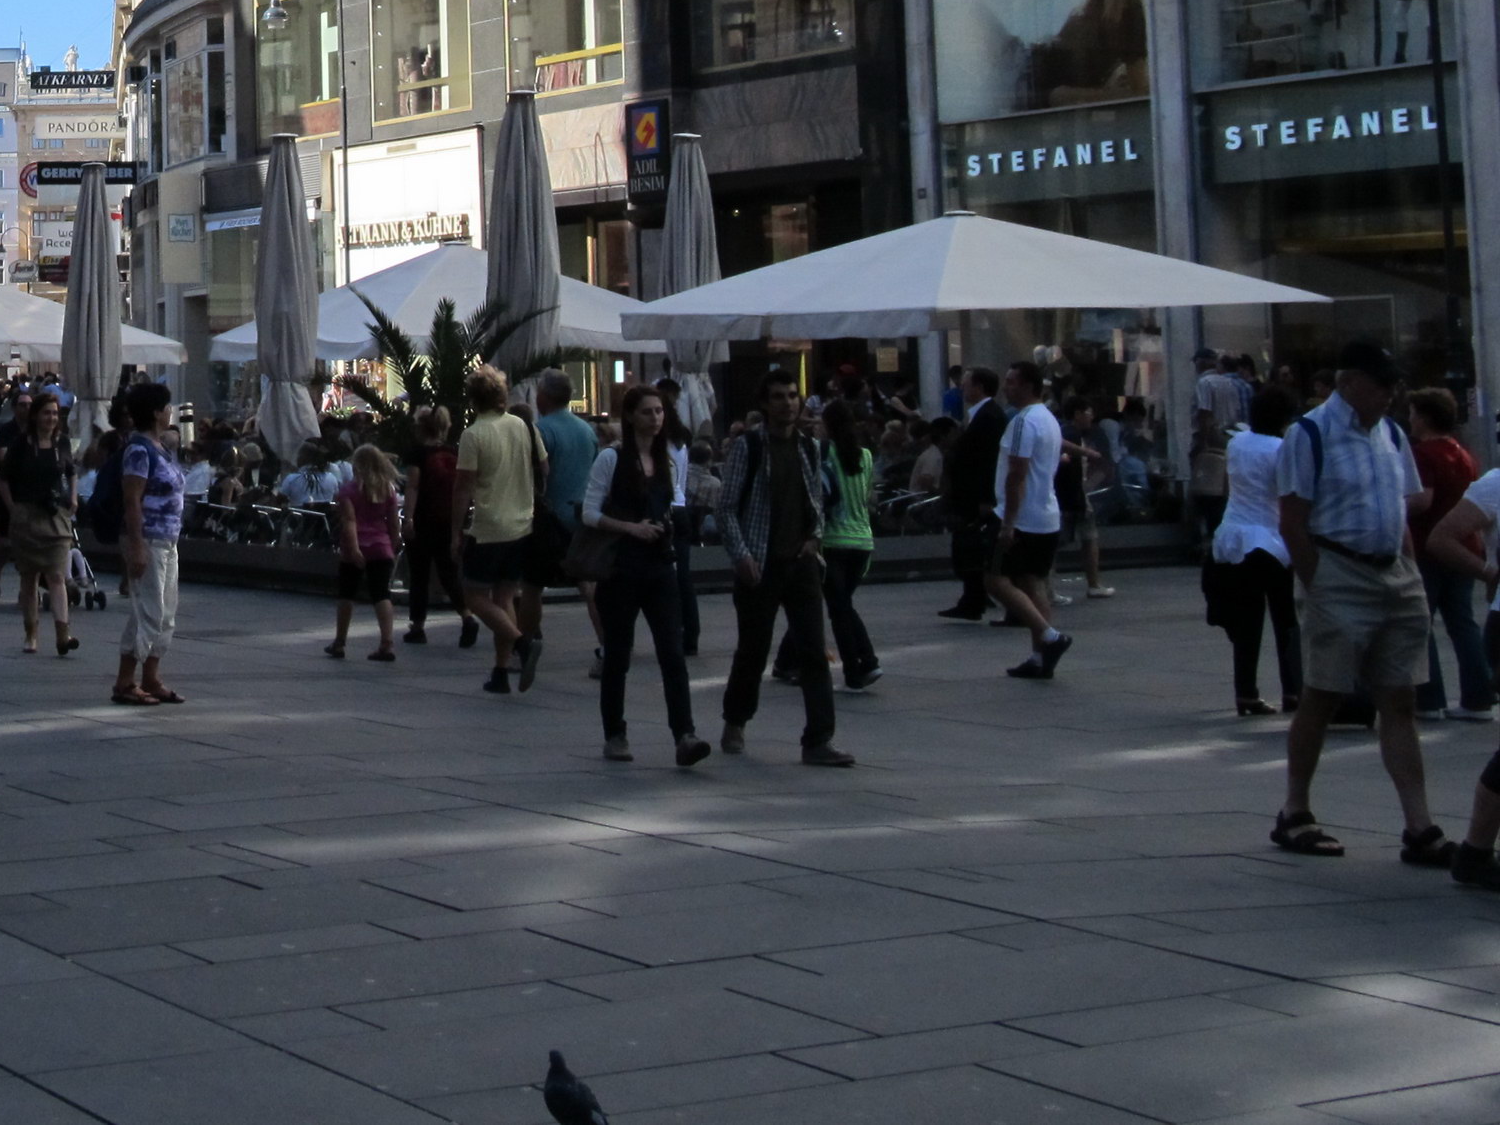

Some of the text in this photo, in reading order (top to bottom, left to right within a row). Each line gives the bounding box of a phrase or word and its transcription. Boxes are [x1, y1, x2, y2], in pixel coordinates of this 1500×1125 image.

[1224, 105, 1438, 151] STEFANEL
[633, 158, 661, 175] ADIL
[967, 137, 1138, 177] STEFANEL
[41, 167, 133, 179] GERRY EBER
[630, 175, 665, 194] BESIM
[335, 221, 399, 245] ATMANN
[412, 211, 463, 239] KÜHNE
